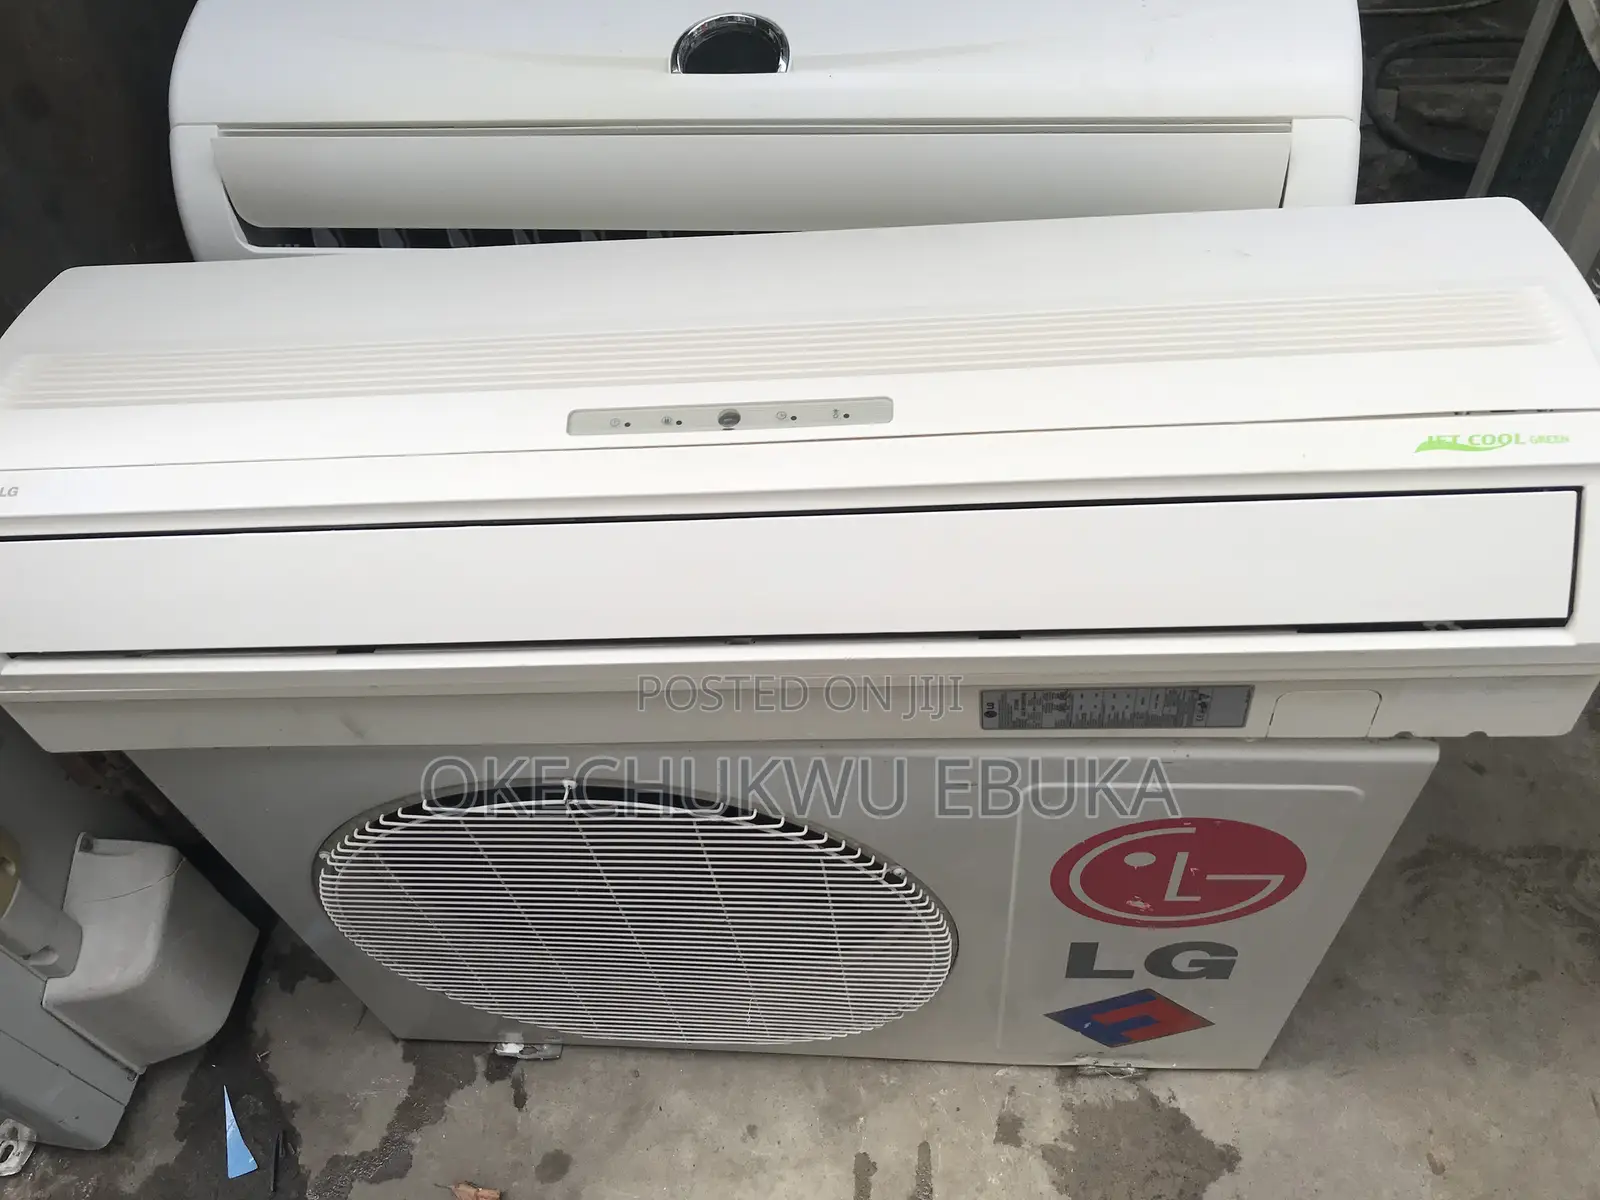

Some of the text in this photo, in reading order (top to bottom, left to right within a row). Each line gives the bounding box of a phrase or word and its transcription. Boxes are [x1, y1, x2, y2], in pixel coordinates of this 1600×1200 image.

[1467, 433, 1526, 446] COOL
[1529, 434, 1570, 445] GREEN
[0, 486, 19, 497] LG
[1064, 941, 1239, 980] LG
